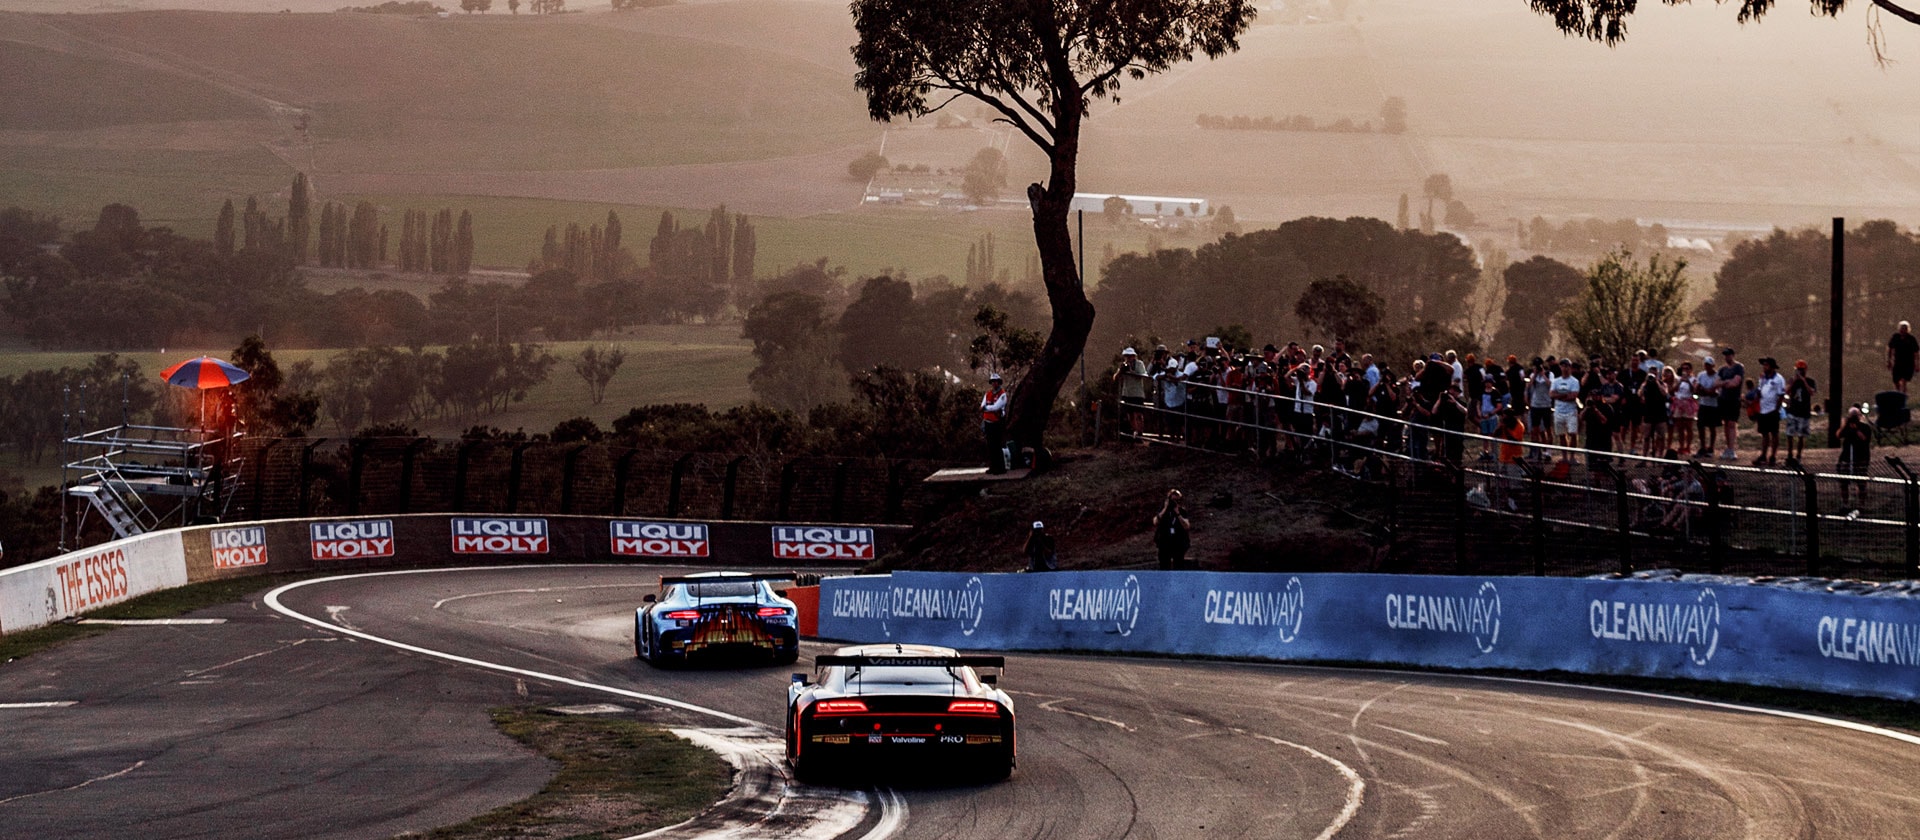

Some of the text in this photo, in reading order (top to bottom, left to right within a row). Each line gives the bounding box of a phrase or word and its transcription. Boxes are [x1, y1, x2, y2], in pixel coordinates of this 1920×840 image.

[314, 522, 388, 540] LIQUI
[457, 520, 542, 535] LIQUI
[616, 523, 702, 539] LIQUI
[778, 528, 868, 543] LIQUI
[213, 529, 262, 549] LIQUI
[316, 538, 391, 557] MOLY
[458, 536, 546, 551] MOLY
[617, 538, 706, 555] MOLY
[215, 545, 265, 567] MOLY
[779, 542, 871, 557] MOLY
[56, 548, 128, 613] THE ESSES
[833, 588, 891, 620] CLEANAWA
[892, 587, 979, 619] CLEANAWAY
[1049, 588, 1136, 621] CLEANAWAY
[1204, 589, 1299, 626] CLEANAWAY
[1386, 593, 1495, 635] CLEANAWAY
[1590, 599, 1714, 645] CLEANAWAY
[1818, 615, 1920, 667] CLEANAW
[868, 657, 949, 666] Valvoline
[891, 736, 926, 744] Valvoline
[940, 734, 964, 744] PRO
